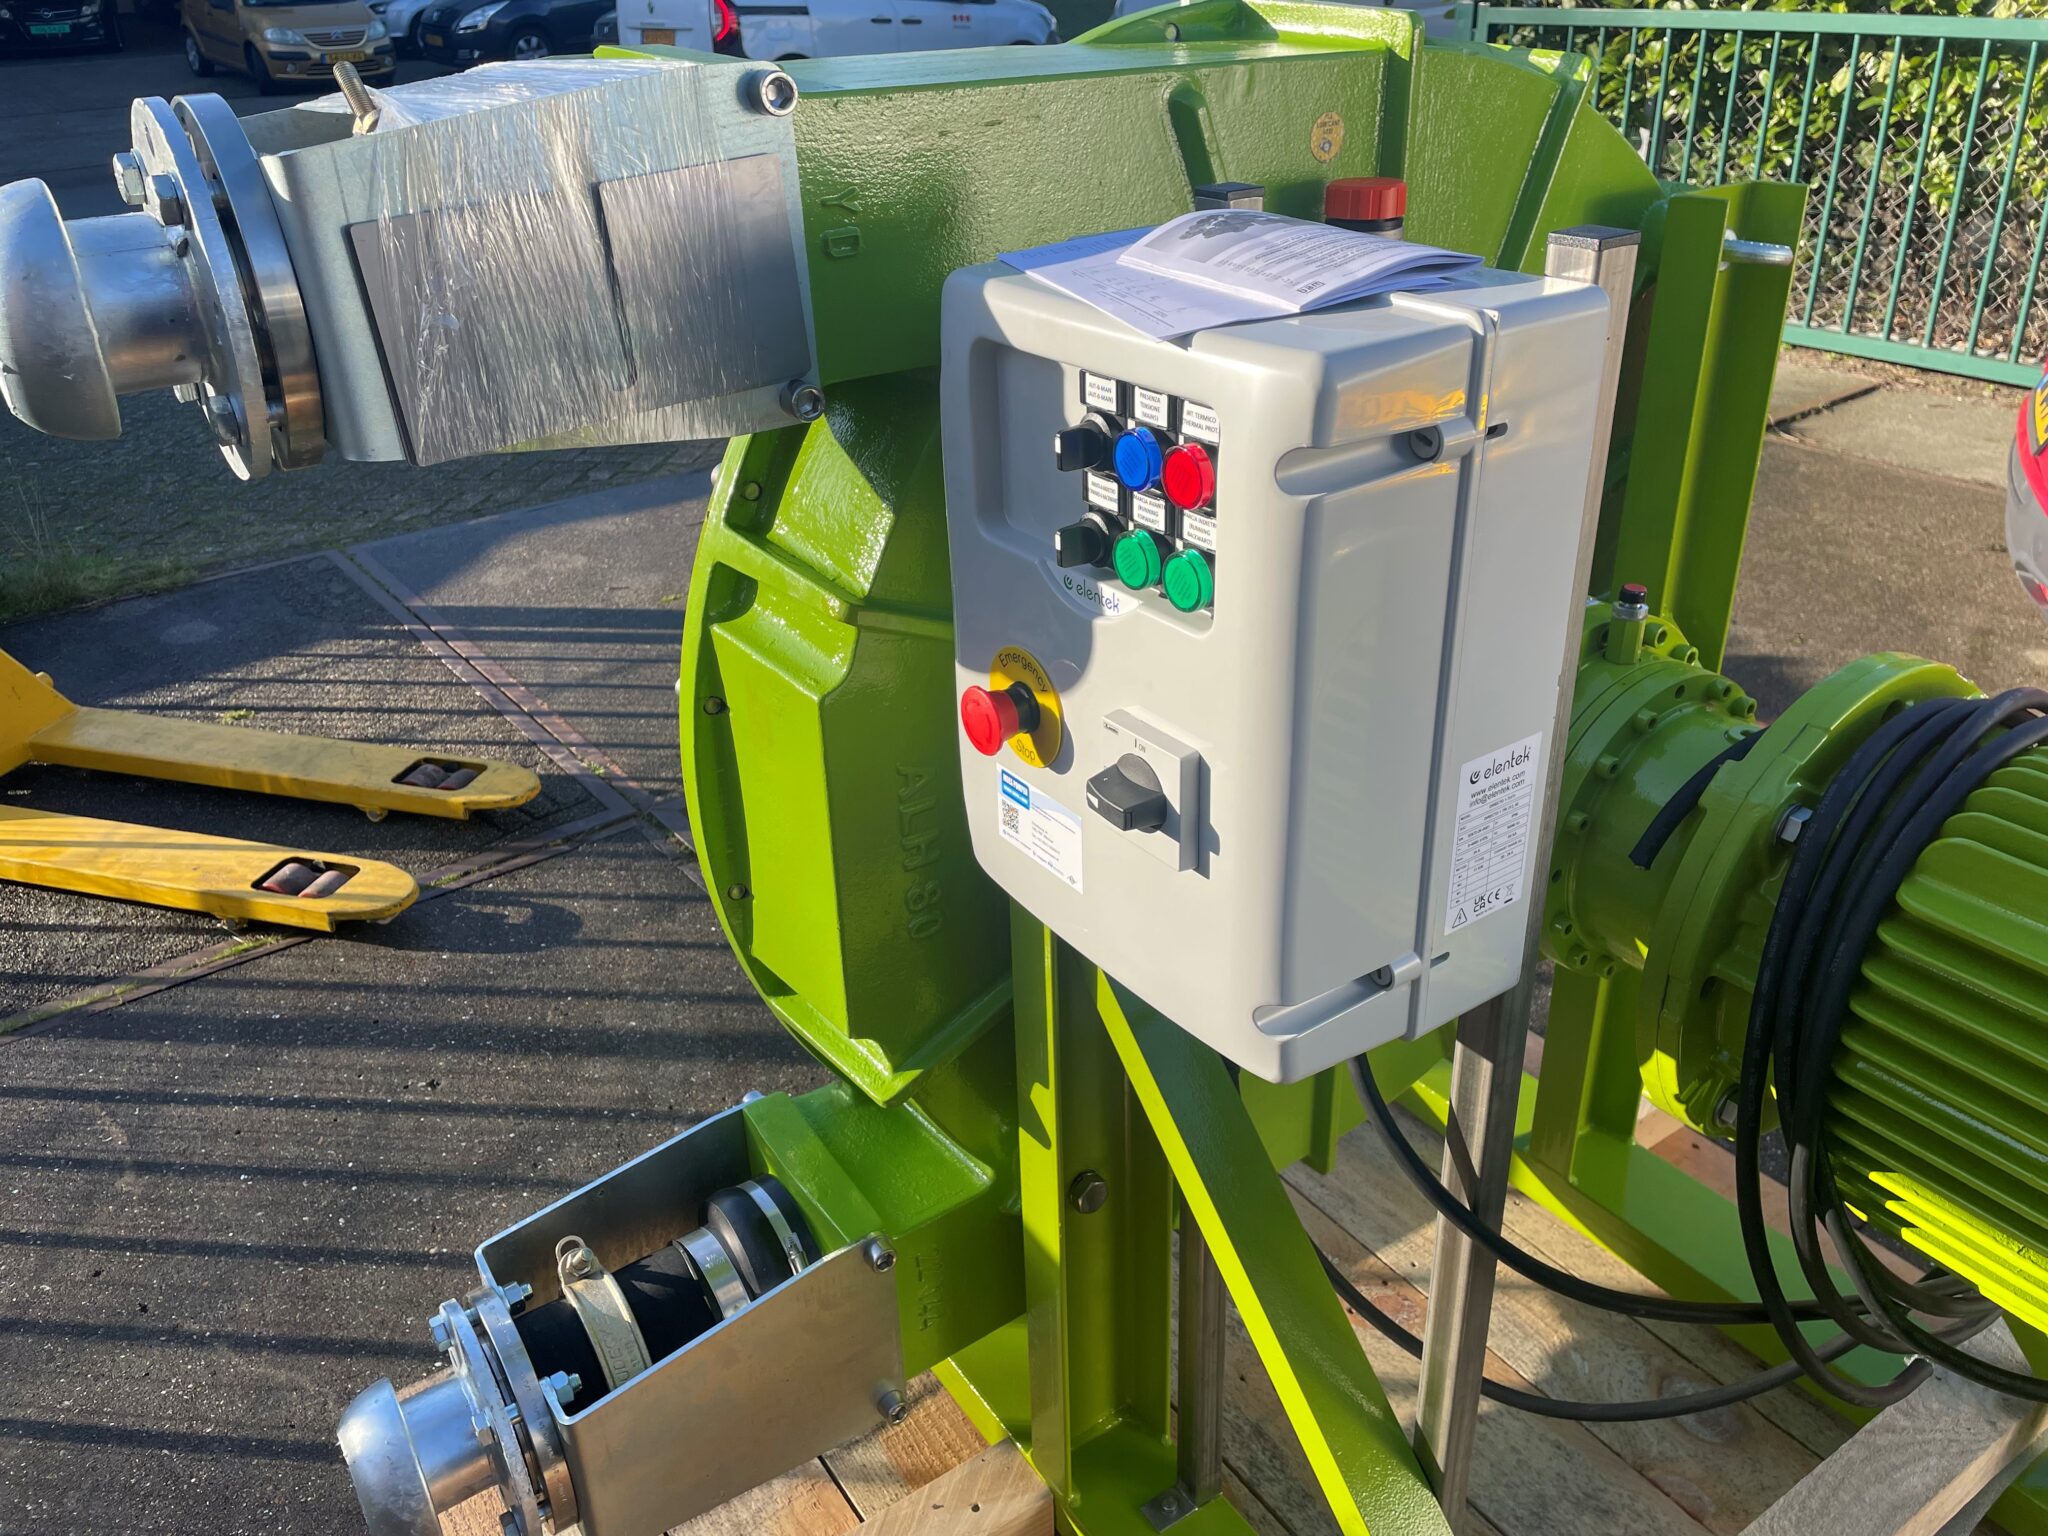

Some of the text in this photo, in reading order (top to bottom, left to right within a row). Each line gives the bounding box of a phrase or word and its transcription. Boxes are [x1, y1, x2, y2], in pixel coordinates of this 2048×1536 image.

[1139, 392, 1161, 403] PRESENZA
[1195, 412, 1216, 424] TERMICO
[1076, 579, 1120, 613] elentek
[998, 652, 1048, 694] Emergency
[1015, 738, 1036, 762] Stop
[1484, 746, 1531, 780] elentek
